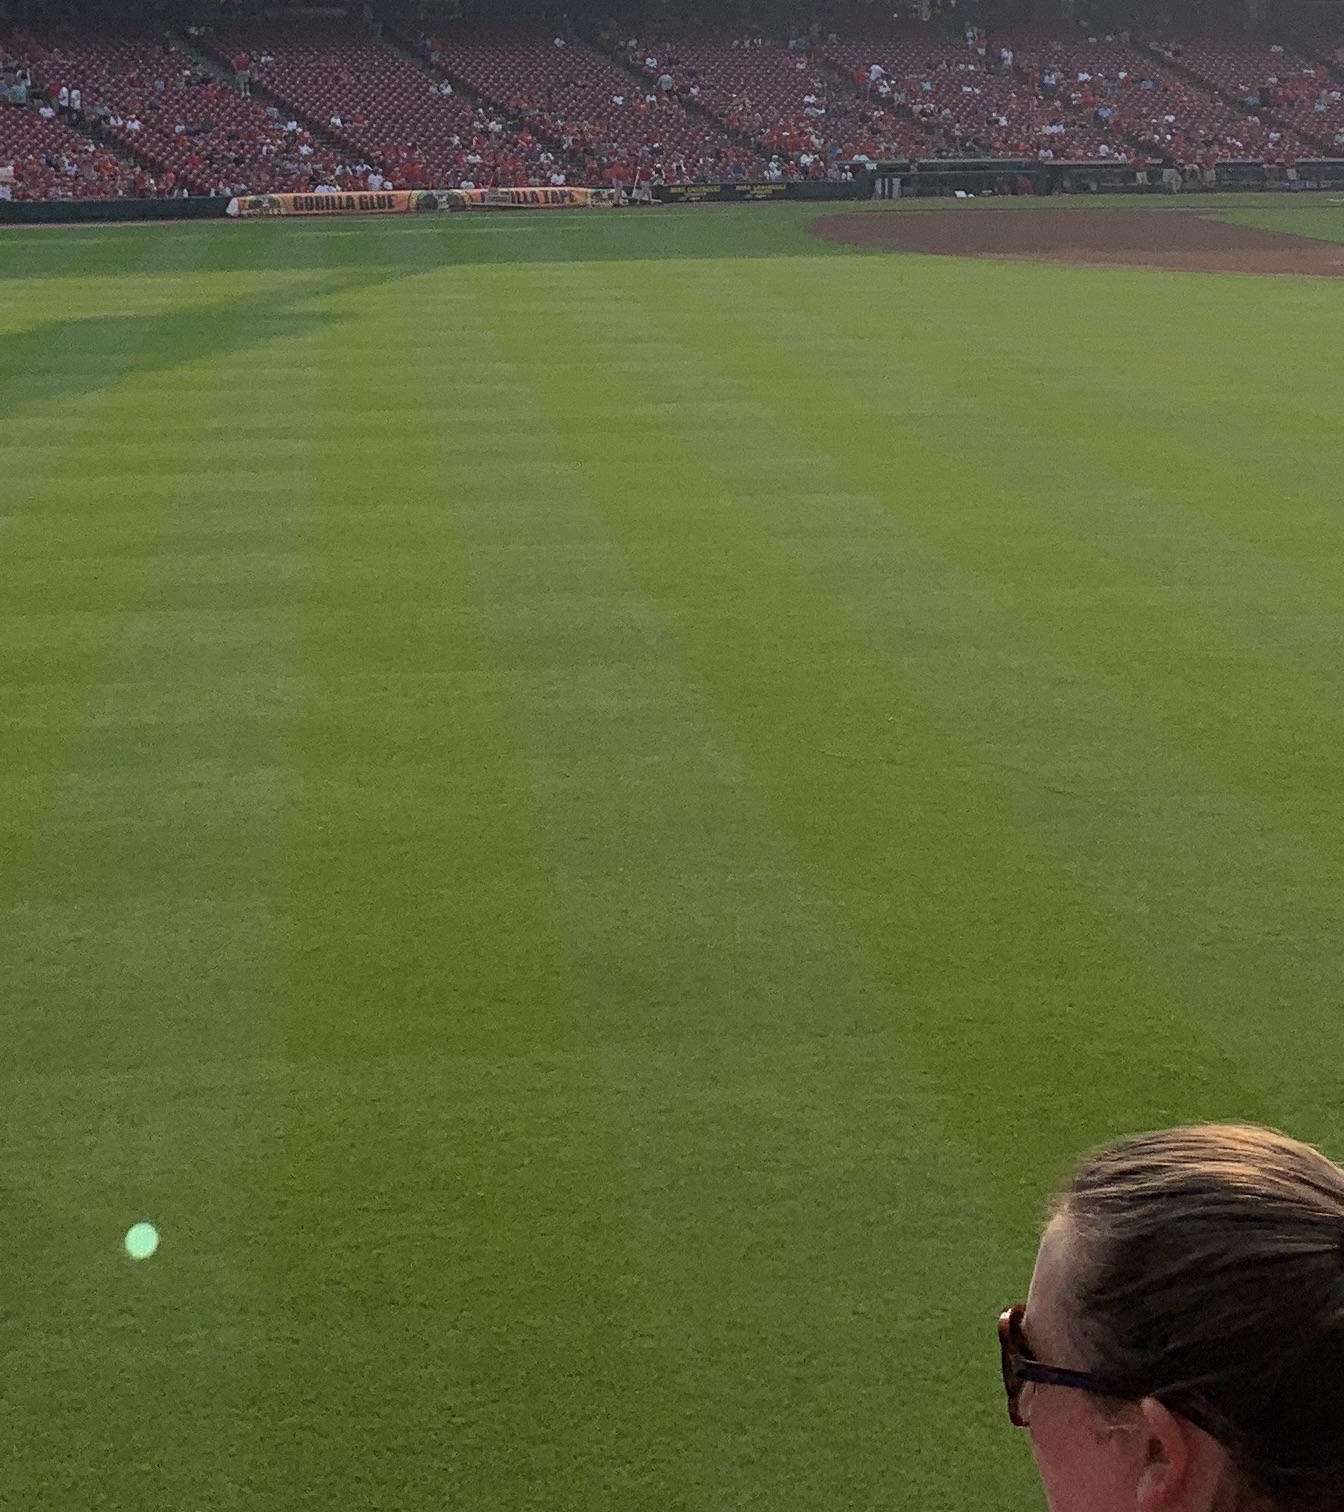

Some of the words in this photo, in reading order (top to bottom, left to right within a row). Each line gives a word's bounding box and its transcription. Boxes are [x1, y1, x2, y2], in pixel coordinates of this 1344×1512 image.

[292, 193, 356, 212] GORILLA
[358, 193, 396, 210] GLUE
[540, 189, 576, 205] TAPE
